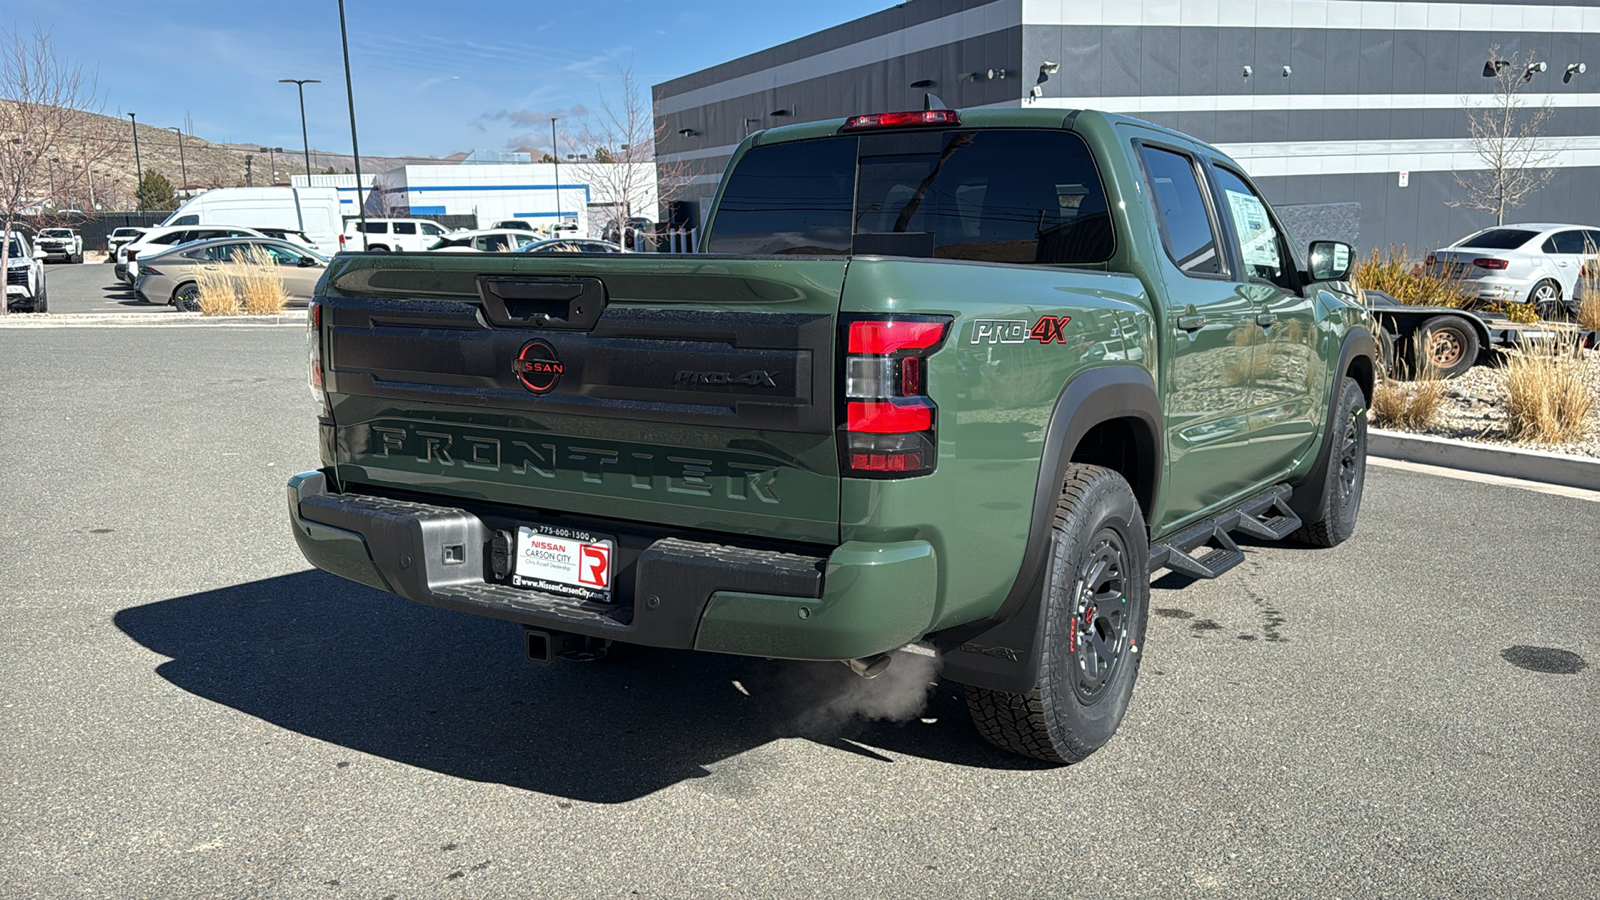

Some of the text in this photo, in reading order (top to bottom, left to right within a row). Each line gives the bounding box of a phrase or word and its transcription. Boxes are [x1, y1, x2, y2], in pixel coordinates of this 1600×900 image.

[970, 315, 1071, 344] PRO-4X
[513, 358, 564, 374] NISSAN
[673, 370, 781, 387] PRO-4X
[372, 426, 780, 504] FRONTIER
[540, 525, 590, 540] 775-600-1500
[531, 540, 566, 552] NISSAN
[525, 548, 572, 563] CARSON CITY
[525, 558, 536, 566] Chris
